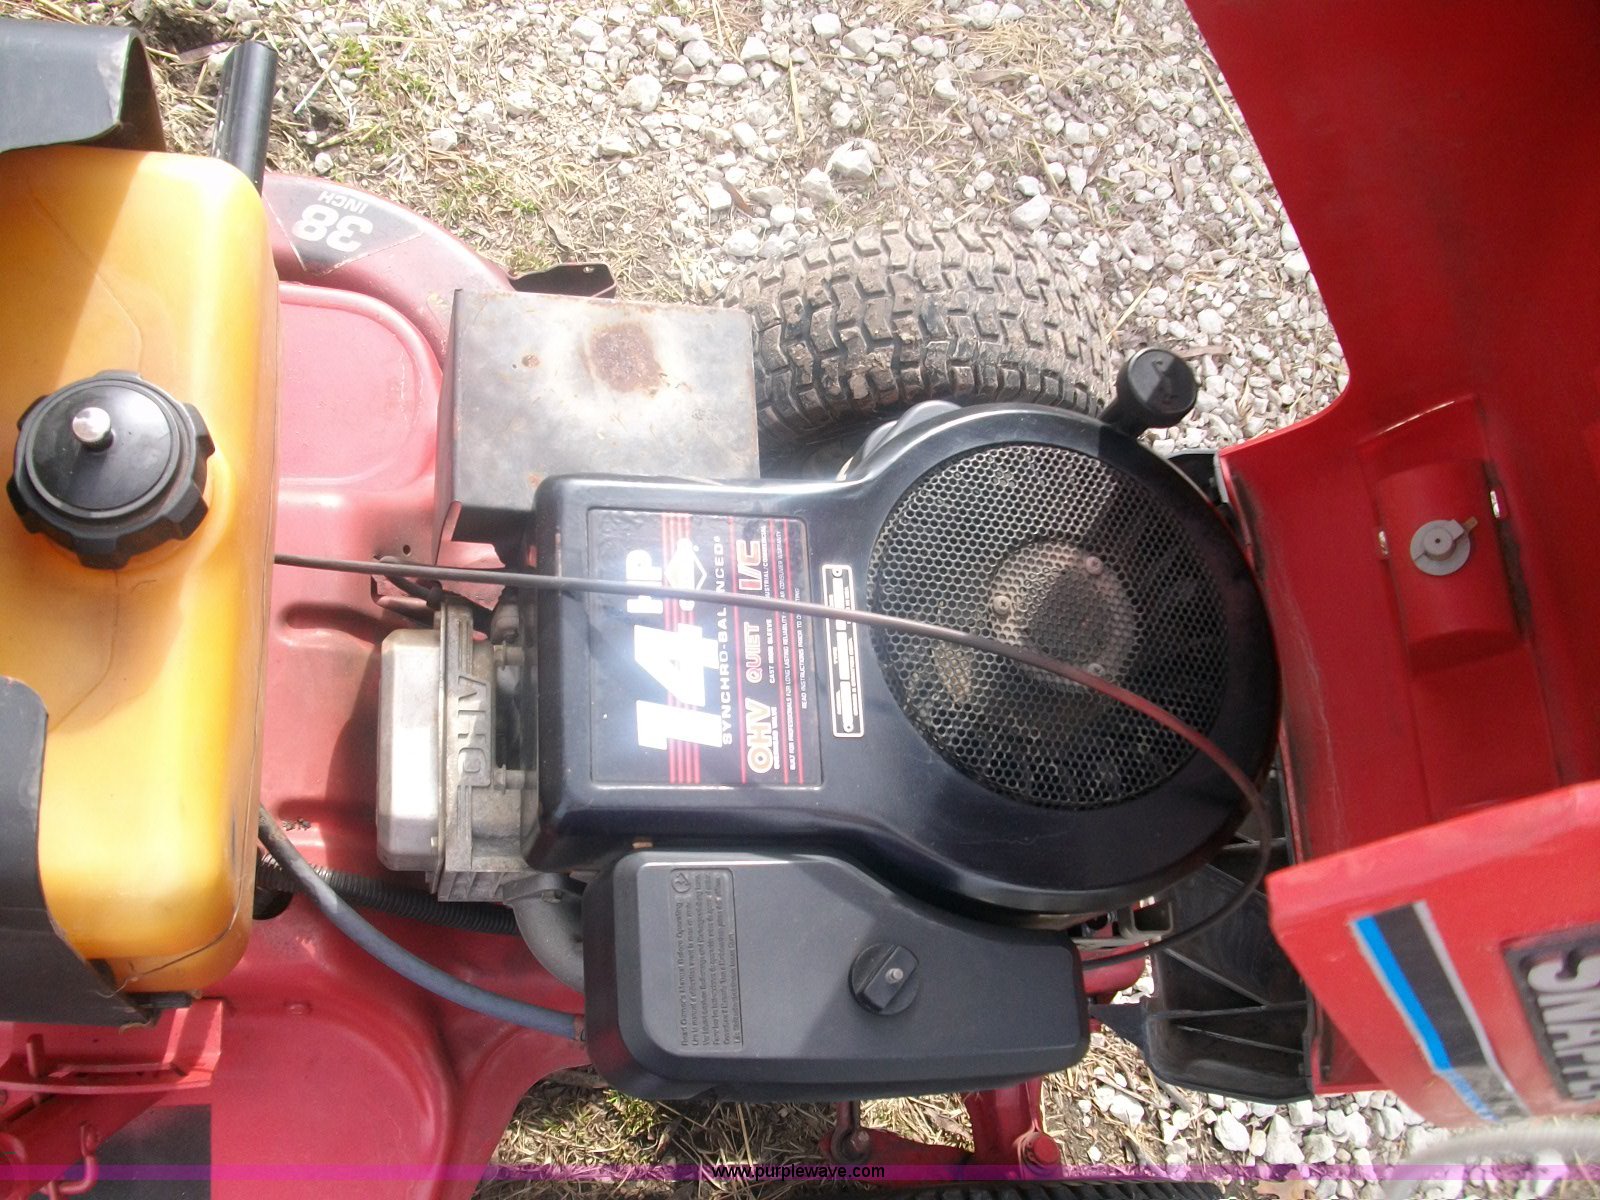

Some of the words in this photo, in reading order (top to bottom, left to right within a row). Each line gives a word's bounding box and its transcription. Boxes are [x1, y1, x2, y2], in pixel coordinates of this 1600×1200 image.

[292, 204, 373, 252] 38
[318, 191, 367, 214] INCH
[714, 544, 732, 744] SYNCHRO-BALNCED
[744, 622, 762, 683] QUIET
[634, 622, 723, 751] 14
[457, 676, 486, 780] OHV
[745, 698, 773, 773] OHV
